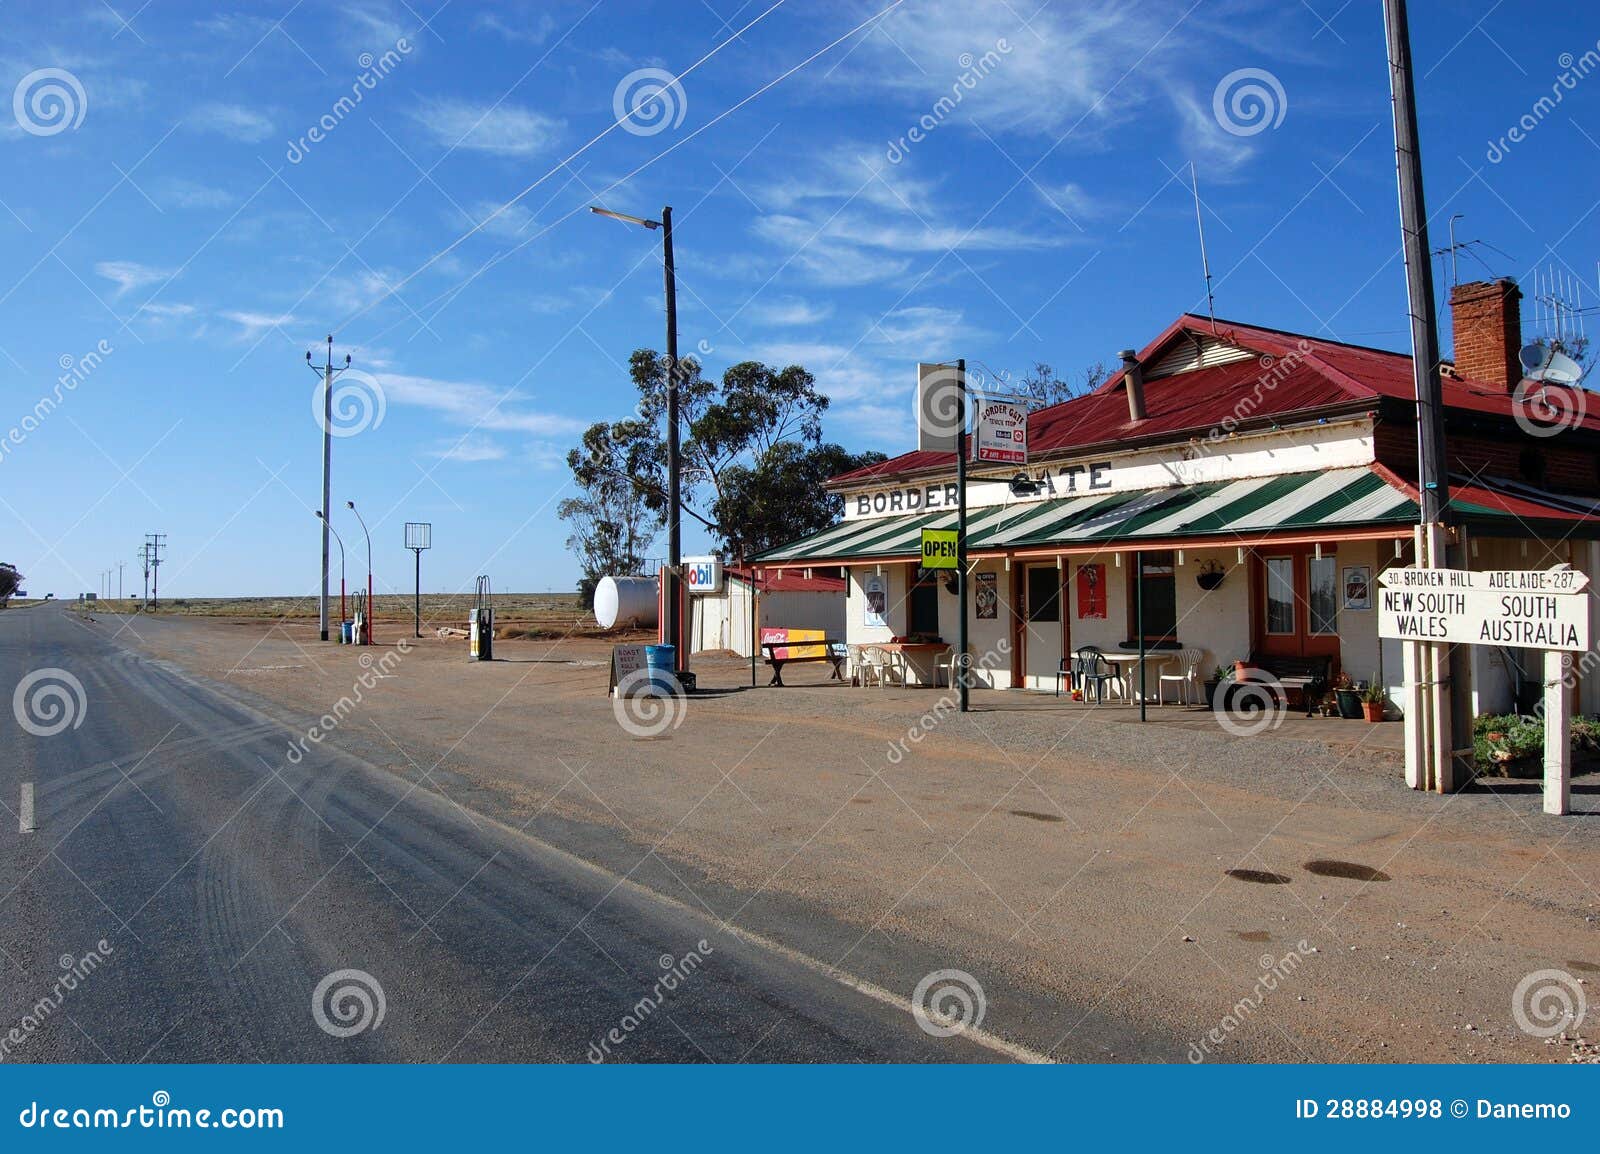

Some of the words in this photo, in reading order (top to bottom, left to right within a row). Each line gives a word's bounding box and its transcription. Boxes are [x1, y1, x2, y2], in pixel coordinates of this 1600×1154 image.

[857, 483, 959, 515] BORDER
[1009, 461, 1112, 498] ATE
[924, 540, 956, 557] OPEN
[689, 564, 712, 585] obil
[1404, 572, 1443, 586] BROKEN
[1450, 572, 1474, 587] HILL
[1553, 573, 1574, 588] 287
[1384, 592, 1413, 612] NEW
[1418, 593, 1465, 615] SOUTH
[1501, 596, 1557, 619] SOUTH
[1397, 615, 1447, 637] WALES
[1480, 619, 1579, 646] AUSTRALIA
